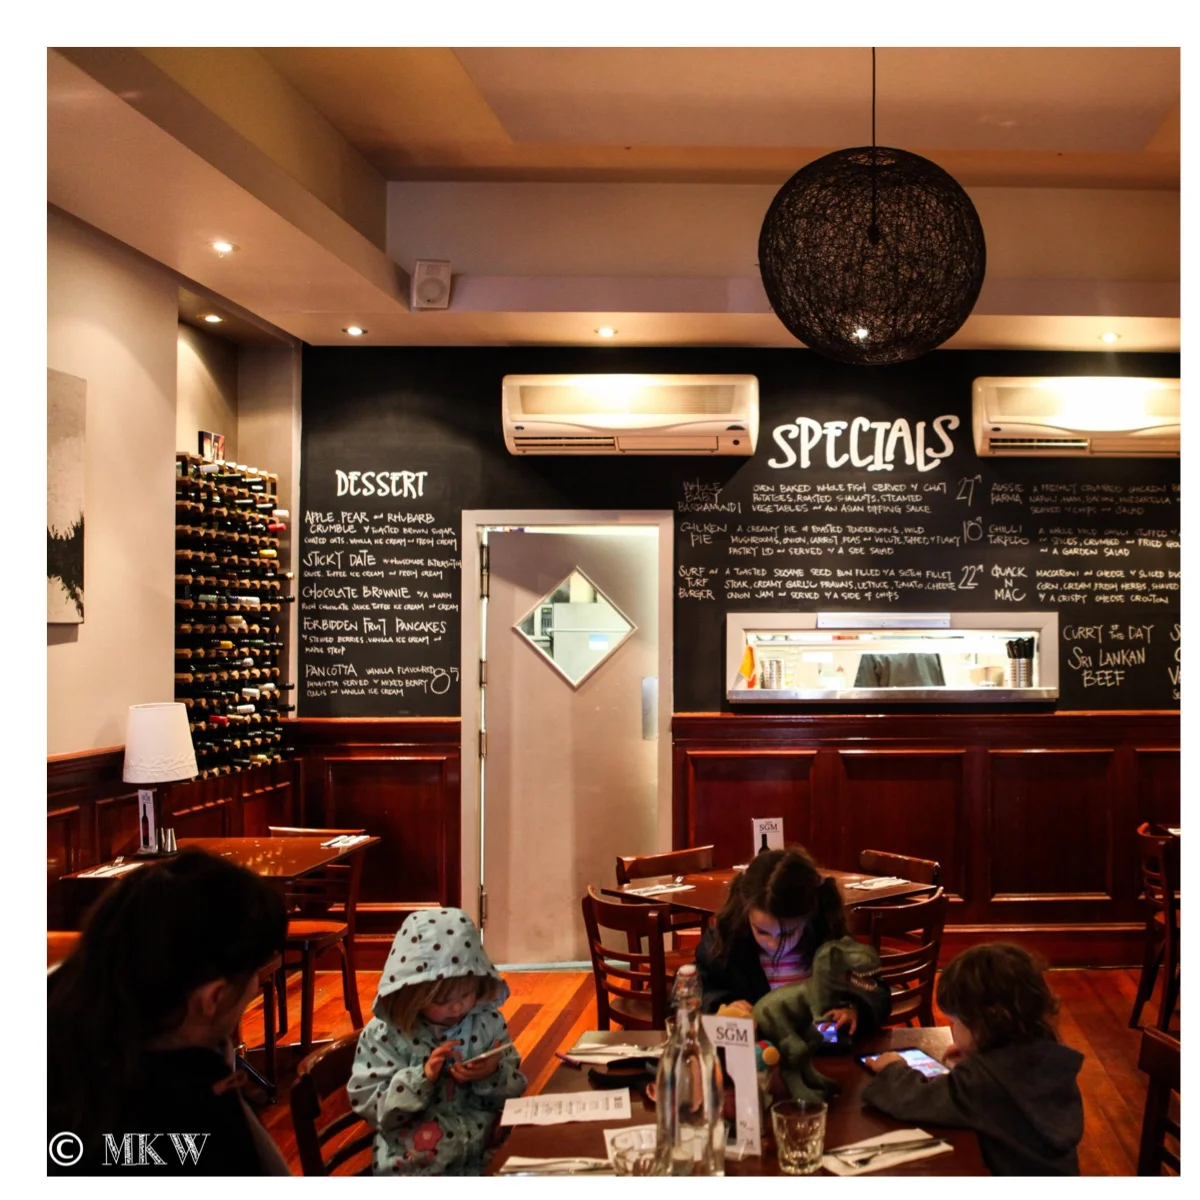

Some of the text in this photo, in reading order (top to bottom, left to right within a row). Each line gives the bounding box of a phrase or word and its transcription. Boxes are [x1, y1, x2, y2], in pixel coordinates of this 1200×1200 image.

[768, 415, 960, 472] SPECIALS
[335, 469, 428, 499] DESSERT
[683, 478, 906, 493] WHOLE OVEN BAKED WHOLE FISH SERVED
[685, 491, 720, 503] BABY
[678, 502, 932, 513] BARRAMUNDI VEGETABLES ASIAN SAUCE
[388, 512, 435, 523] RHUBARB
[310, 524, 357, 534] CRUMBLE
[431, 527, 455, 538] SUGAR
[680, 522, 727, 533] CHICKEN
[988, 525, 1022, 534] CHILLI
[690, 532, 713, 547] PIE
[728, 547, 822, 556] PASTRY SERVED
[1062, 548, 1130, 556] GARDEN SALAD
[303, 550, 376, 569] STICKY DATE
[678, 565, 705, 577] SURF
[925, 570, 951, 581] FILLET
[991, 564, 1028, 579] QUACK
[302, 582, 411, 599] CHOCOLATE BROWNIE
[685, 577, 782, 589] TURF CREAMY
[1004, 579, 1013, 588] N
[678, 588, 715, 600] BURGER
[994, 588, 1026, 601] MAC
[1057, 595, 1088, 604] CRISPY
[303, 617, 446, 636] FORBIDDEN FRUIT PANCAKES
[1063, 625, 1104, 644] CURRY
[1129, 625, 1154, 644] DAY
[1067, 646, 1145, 670] SRI LANKAN
[305, 664, 357, 678] PANCOTTA
[366, 667, 394, 675] VANILLA
[1082, 670, 1125, 688] BEEF
[759, 823, 778, 831] SGM
[716, 1026, 748, 1042] SGM
